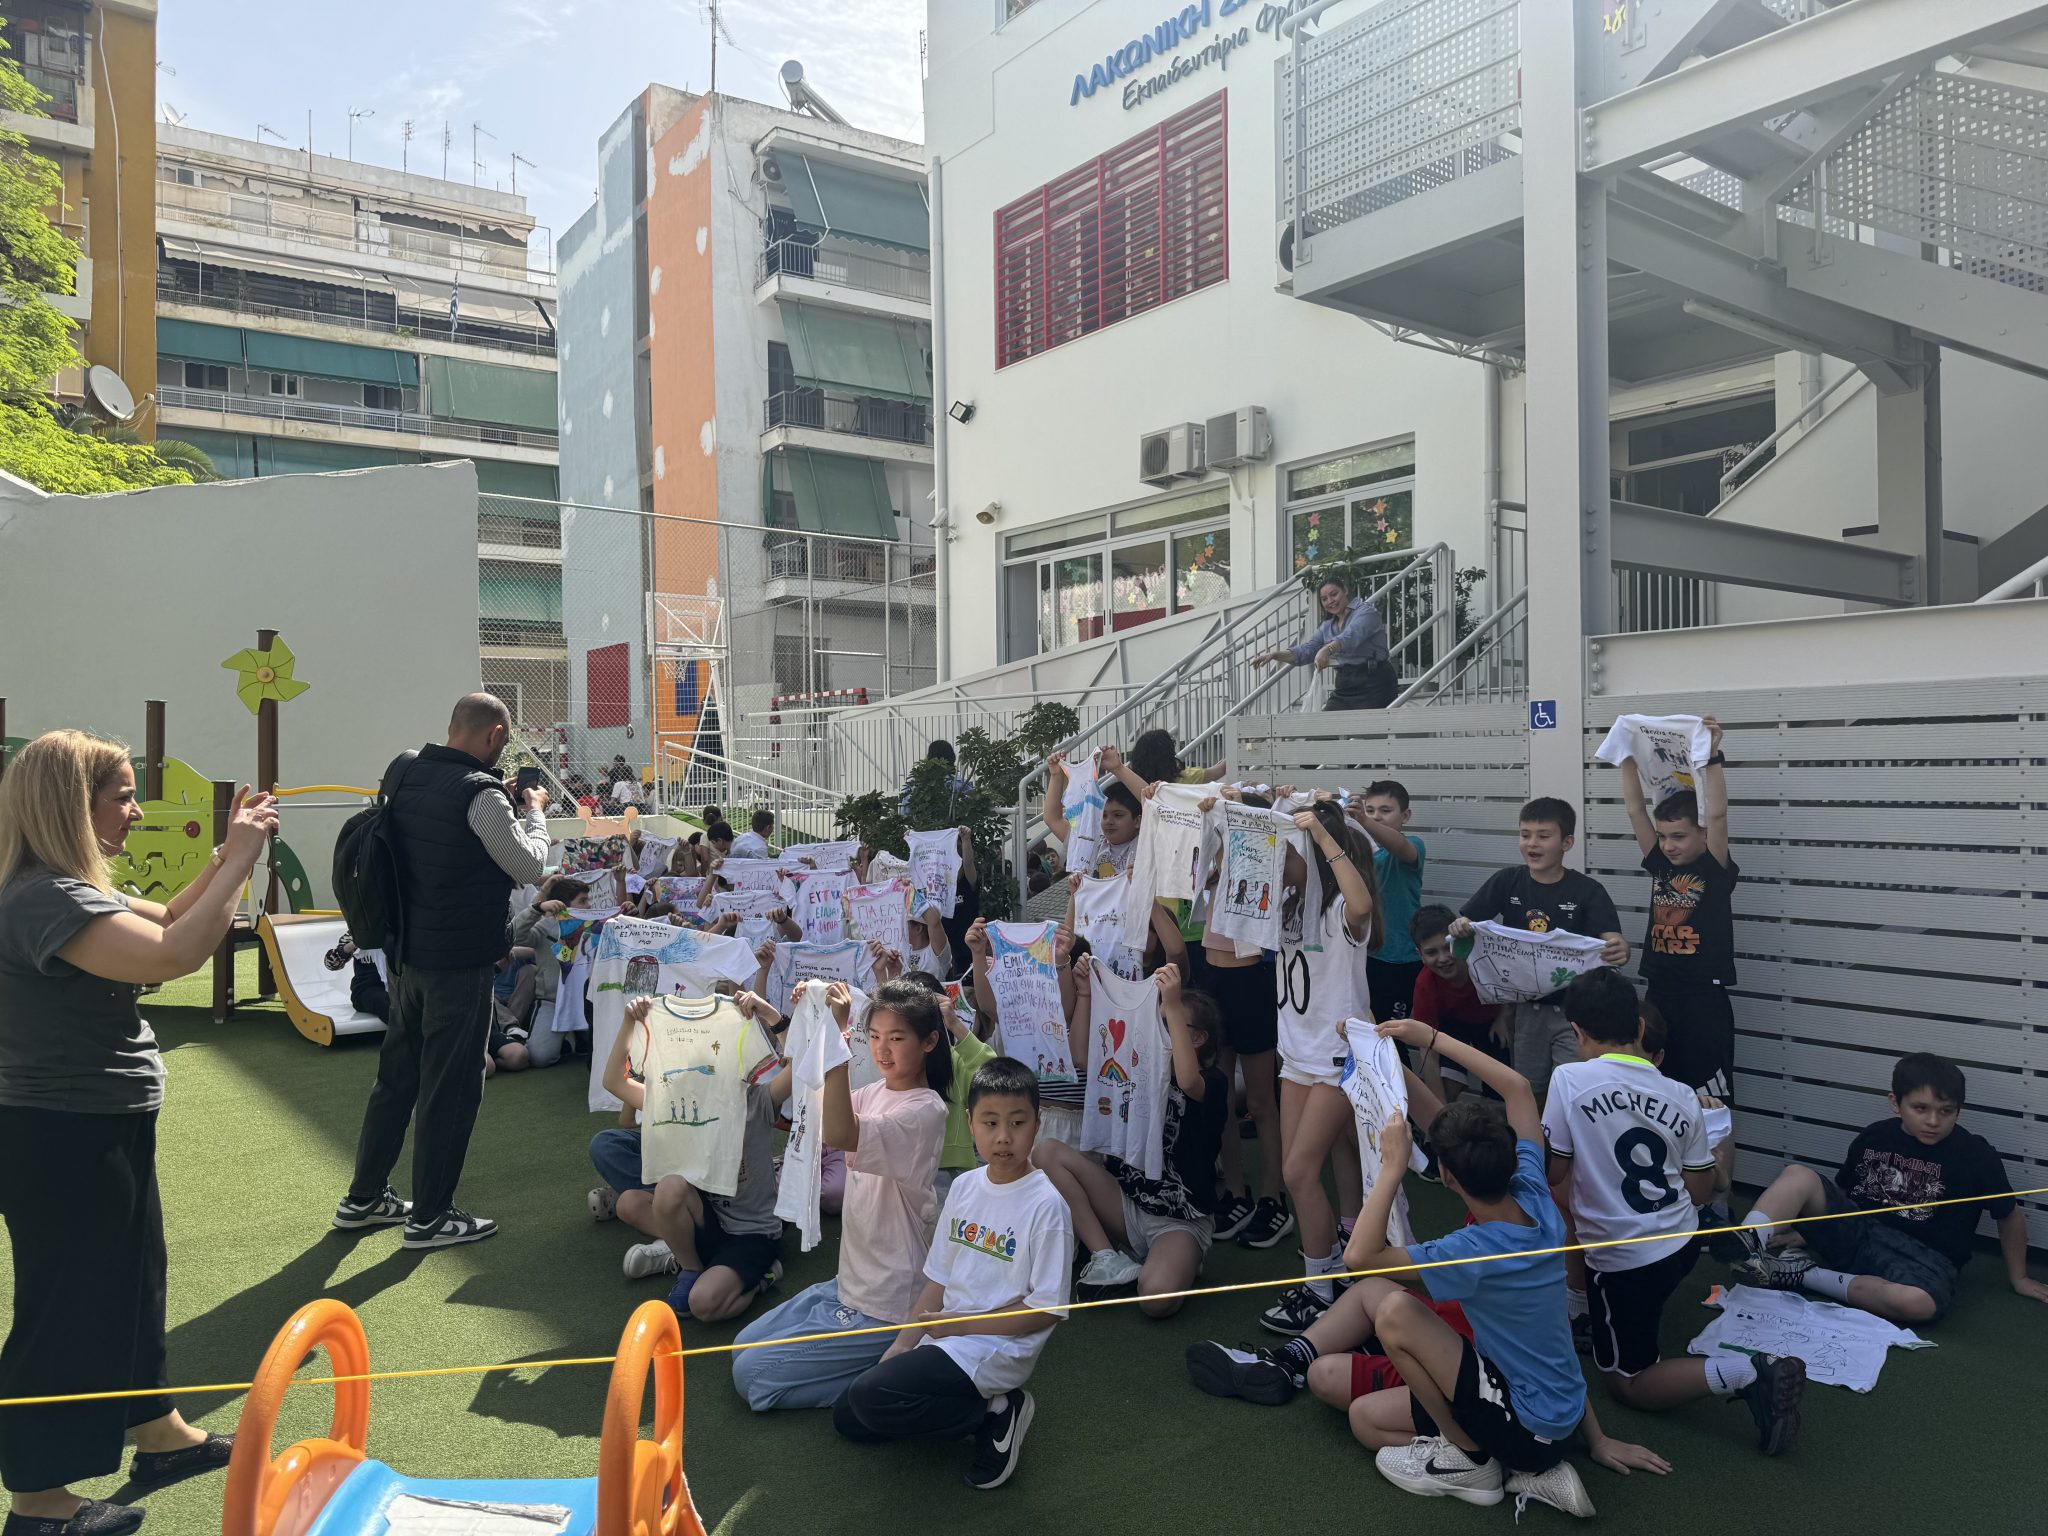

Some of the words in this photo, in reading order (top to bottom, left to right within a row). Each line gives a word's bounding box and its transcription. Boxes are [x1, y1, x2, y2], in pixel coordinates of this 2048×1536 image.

[1122, 26, 1249, 110] Εκπαιδευτήρια
[1580, 1090, 1690, 1138] MICHELIS
[1613, 1126, 1679, 1215] 8
[1863, 1148, 1891, 1166] IRON
[1893, 1153, 1942, 1179] MAIDEN
